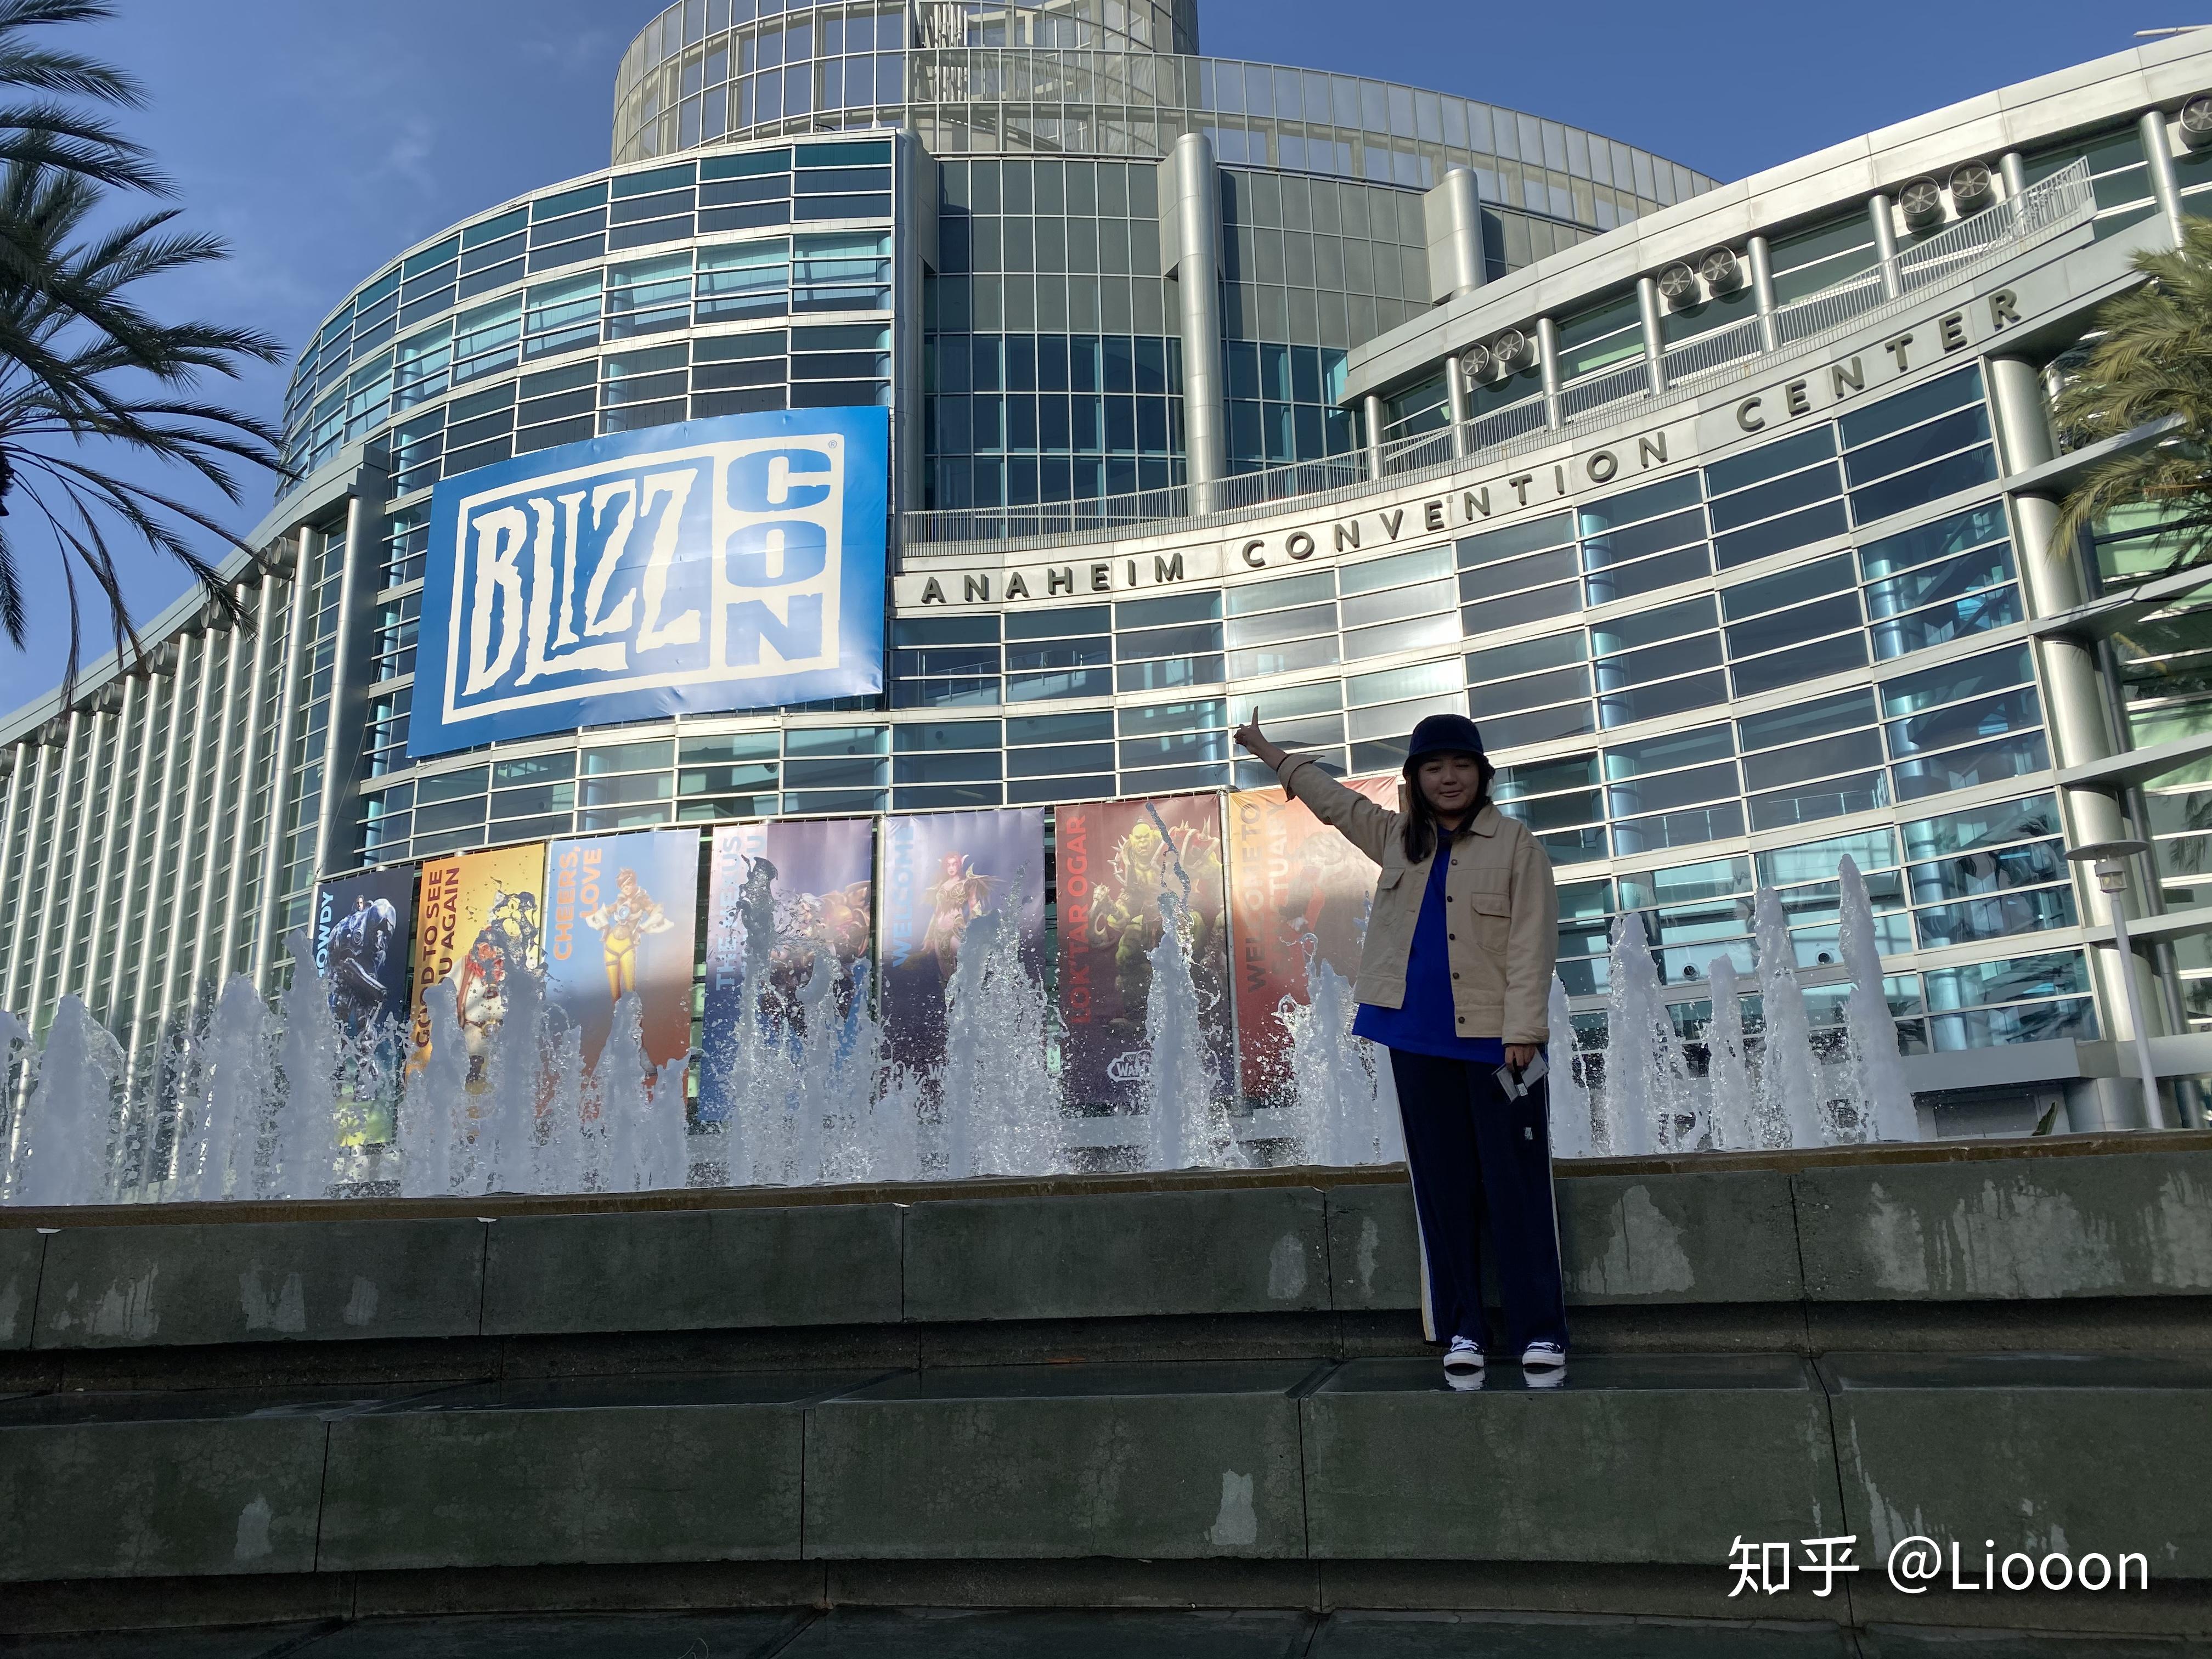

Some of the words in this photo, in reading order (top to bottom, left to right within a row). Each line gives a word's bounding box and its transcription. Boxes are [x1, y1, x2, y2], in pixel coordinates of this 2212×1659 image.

[921, 552, 1184, 604] ANAHEIM
[1242, 431, 1668, 567] CONVENTION
[1736, 289, 2022, 432] CENTER
[461, 467, 700, 696] BLIZZ
[725, 448, 832, 668] CON
[1066, 815, 1088, 898] OGAR
[1240, 803, 1261, 841] TO
[426, 869, 443, 919] SEE
[441, 867, 460, 950] AGAIN
[579, 848, 602, 918] LOVE
[892, 826, 914, 968] WELCOME
[423, 926, 438, 961] TO
[716, 936, 737, 991] THE
[1068, 903, 1091, 1024] LOK'TAR
